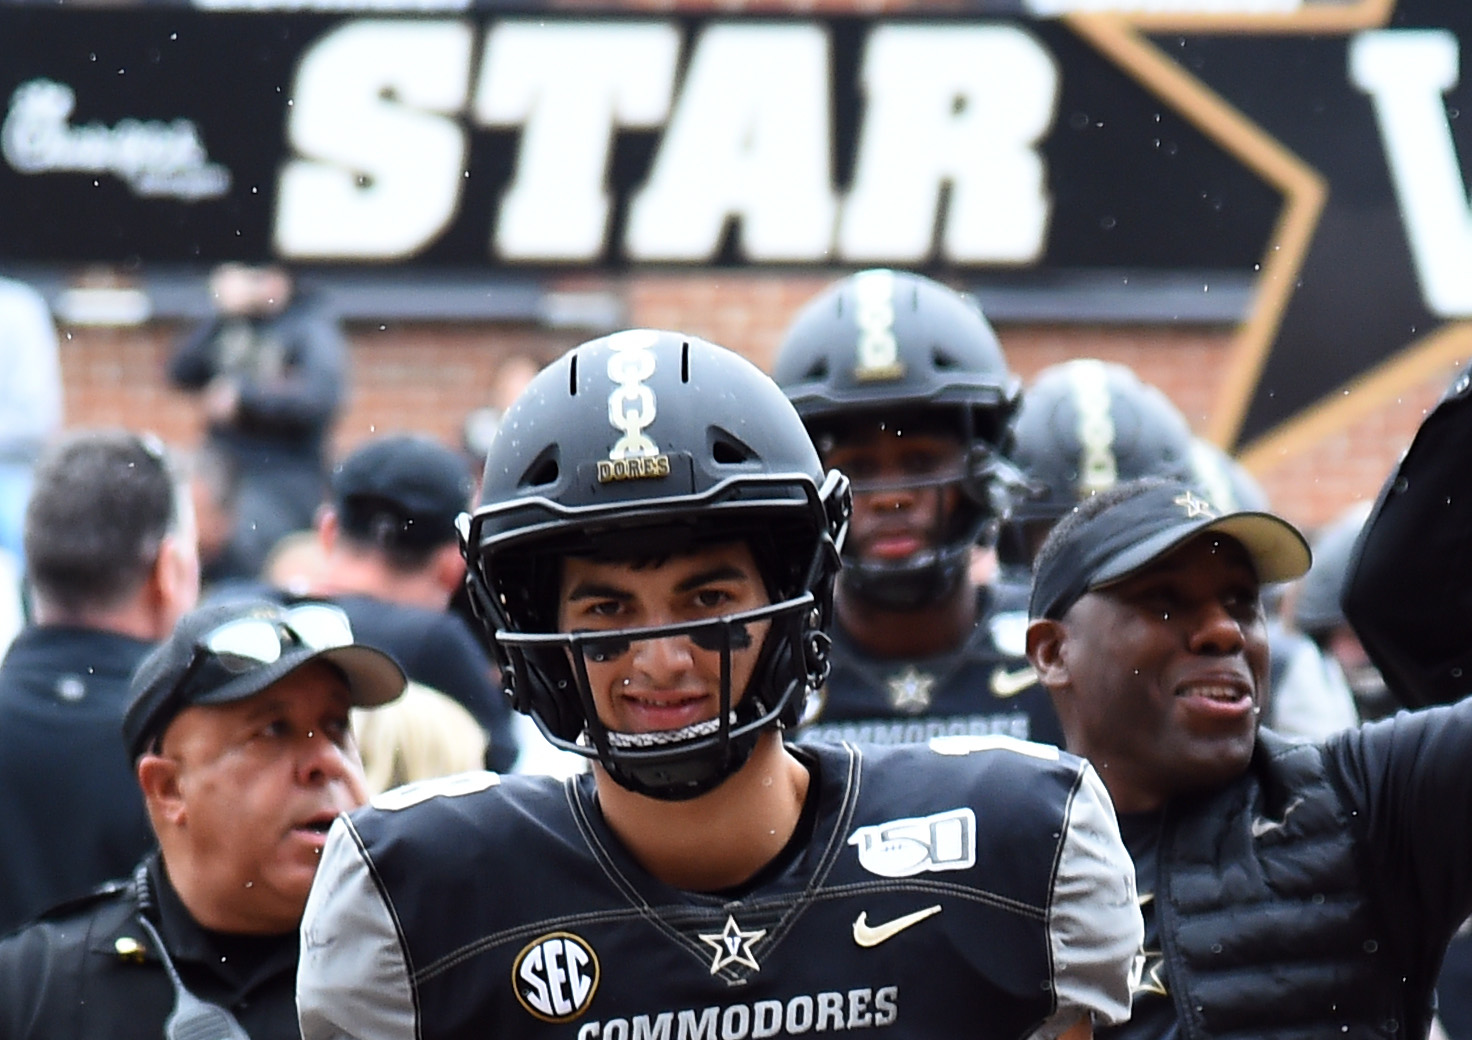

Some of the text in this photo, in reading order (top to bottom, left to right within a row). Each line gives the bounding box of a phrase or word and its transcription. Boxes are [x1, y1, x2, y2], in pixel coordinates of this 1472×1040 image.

[273, 18, 1062, 264] STAR
[597, 455, 670, 482] DORES
[519, 938, 596, 1018] SEC
